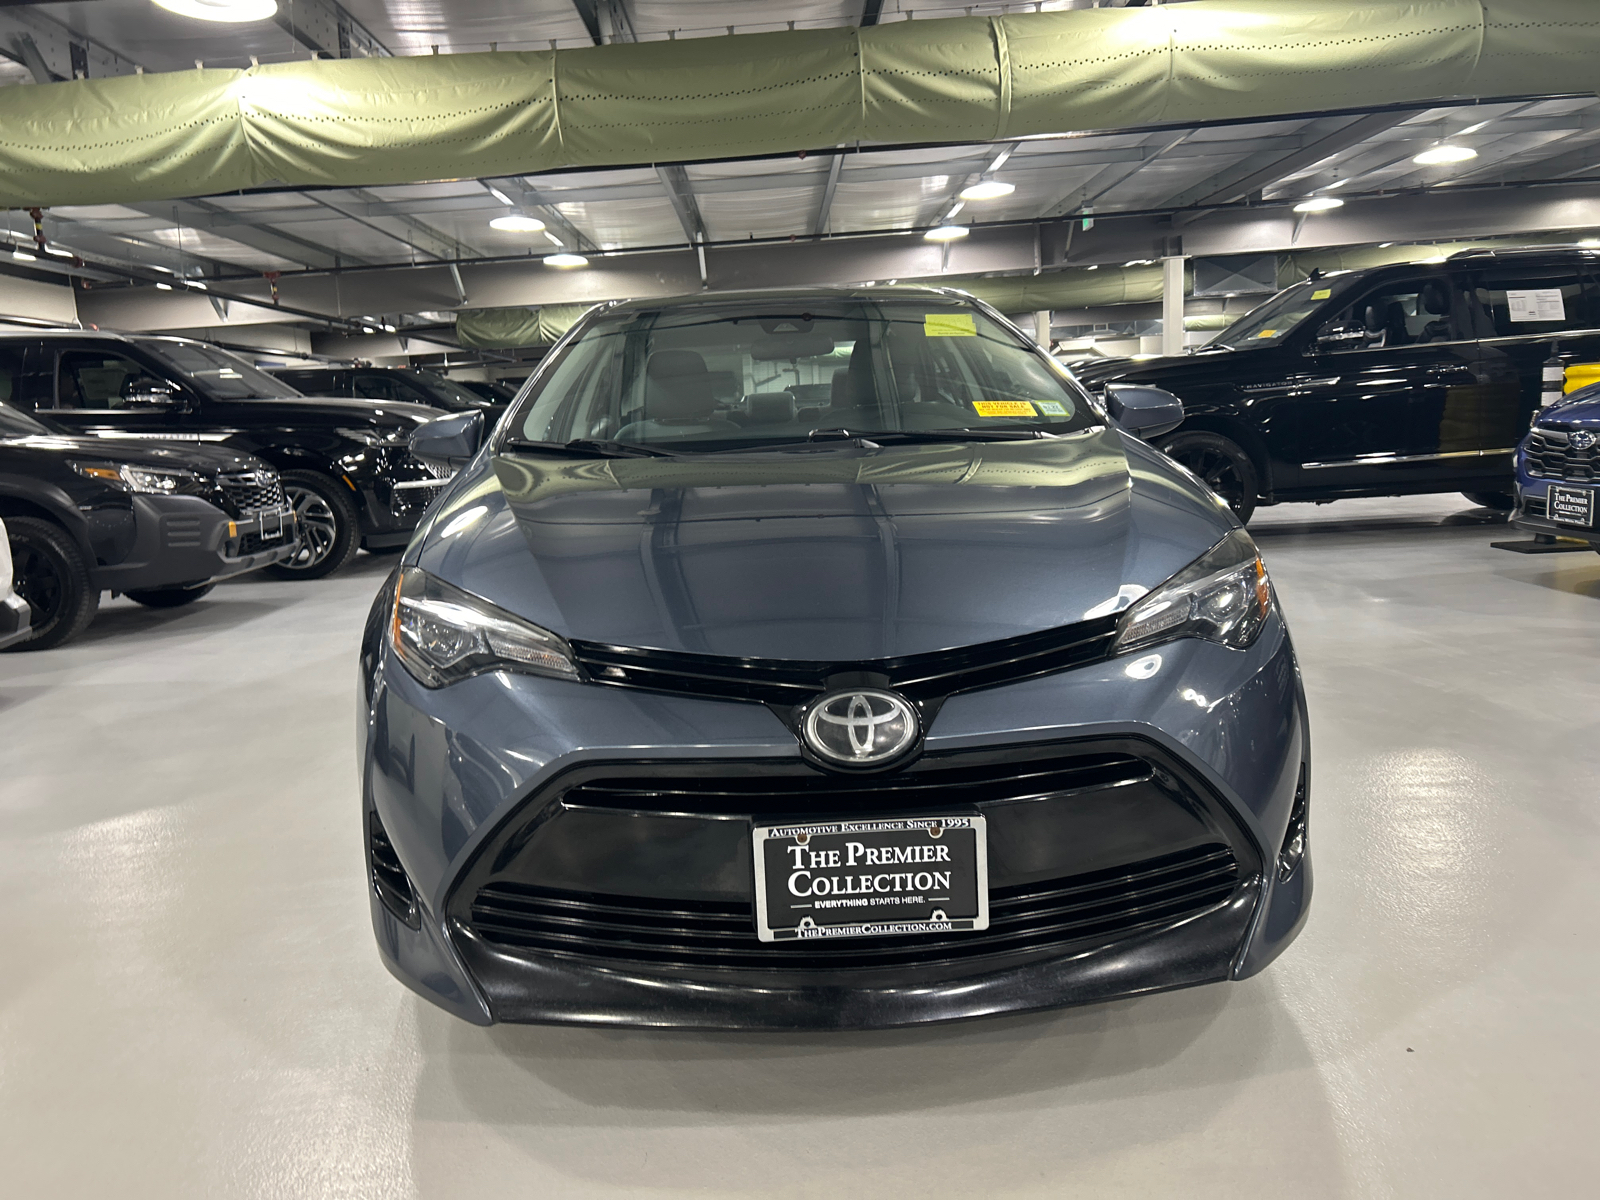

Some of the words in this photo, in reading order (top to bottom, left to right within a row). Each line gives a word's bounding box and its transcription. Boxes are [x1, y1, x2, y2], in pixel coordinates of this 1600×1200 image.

[1246, 381, 1293, 389] NAVIGATOR
[1554, 493, 1566, 502] THE
[1566, 494, 1588, 505] PREMIER
[1554, 501, 1588, 513] COLLECTION
[770, 825, 838, 838] AUTOMOTIVE
[841, 820, 904, 833] EXCELLENCE
[906, 819, 938, 830] SINCE
[940, 818, 969, 828] 1995
[787, 844, 842, 870] THE
[845, 842, 951, 867] PREMIER
[787, 871, 952, 898] COLLECTION
[814, 898, 869, 909] EVERYTHING
[870, 897, 900, 906] STARTS
[901, 896, 926, 904] HERE.
[795, 921, 953, 938] THEPREMIERCOLLECTION.COM
